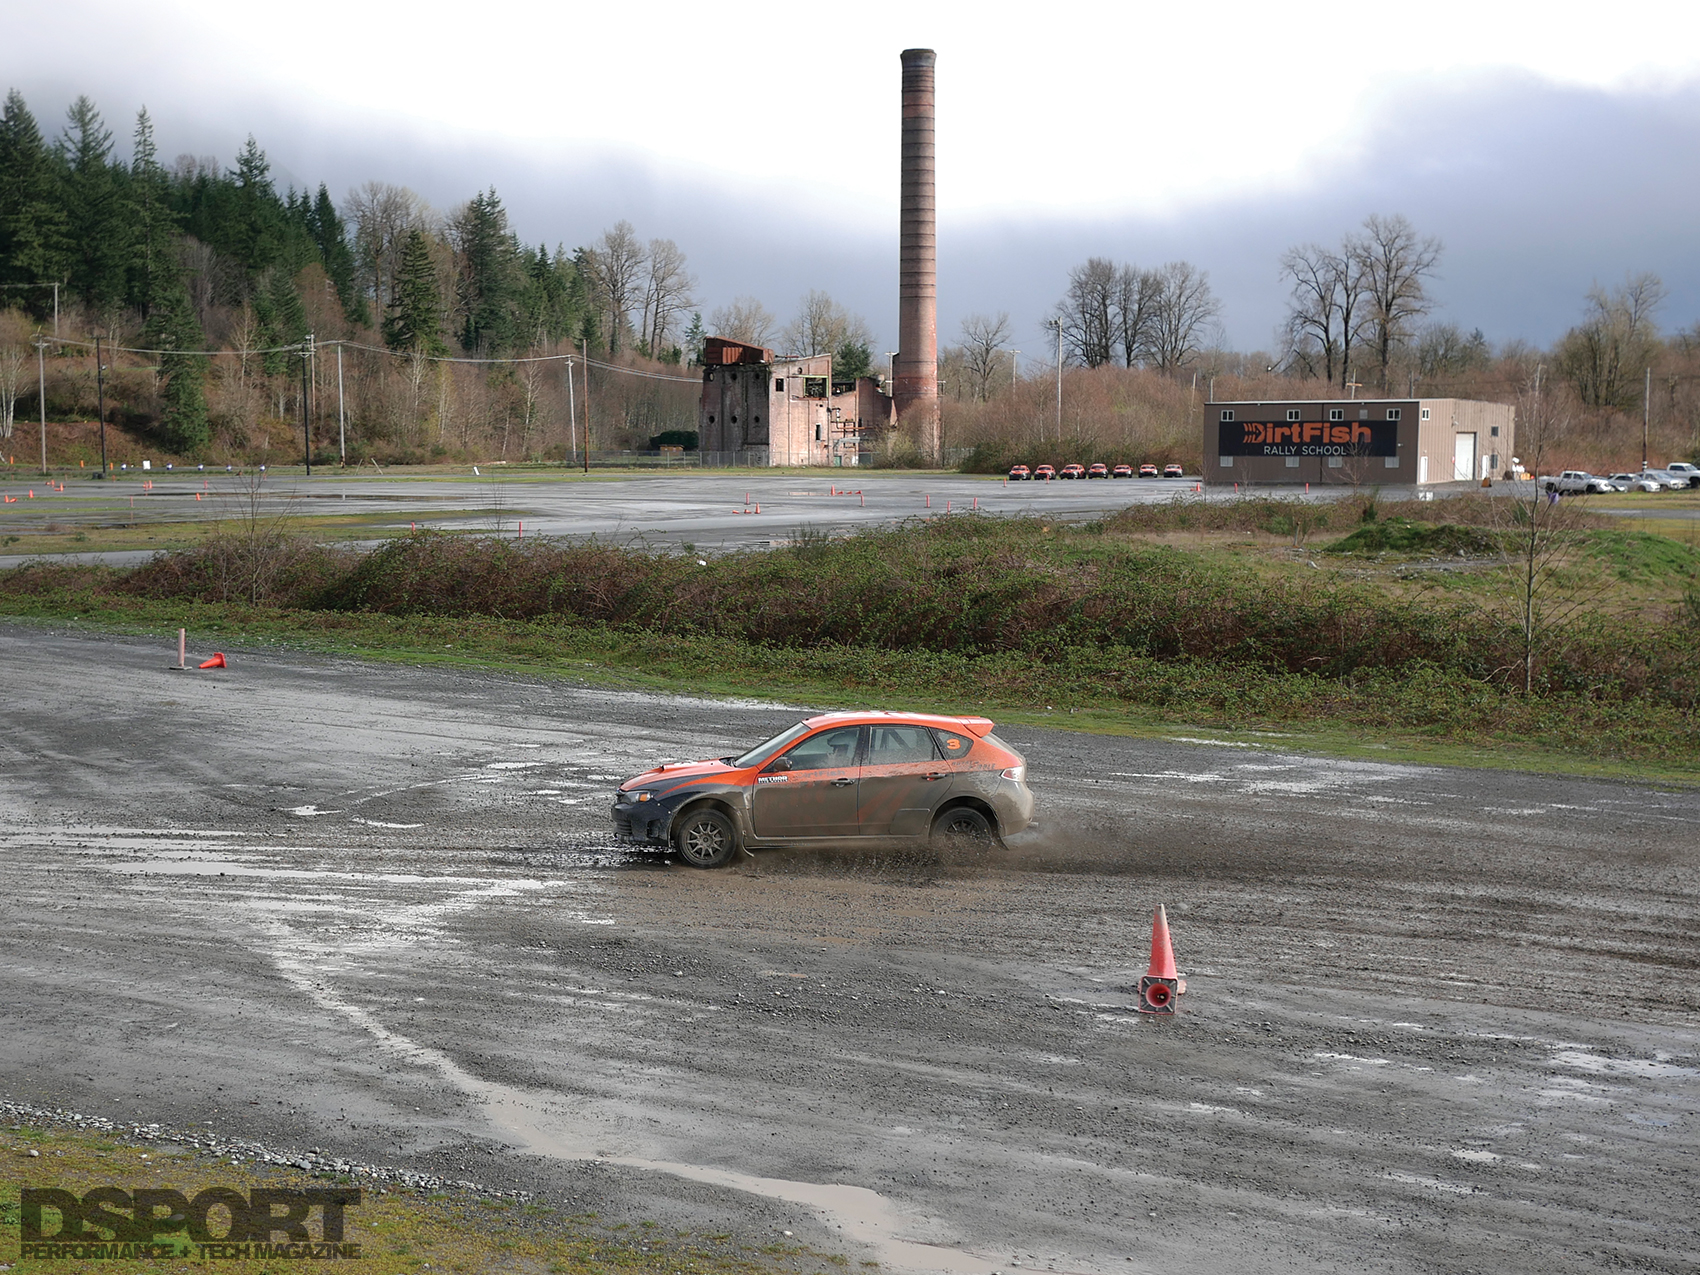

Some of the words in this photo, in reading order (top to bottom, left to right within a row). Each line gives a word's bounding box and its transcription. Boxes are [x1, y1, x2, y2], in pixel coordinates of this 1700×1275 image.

[1243, 422, 1371, 443] DirtFish
[1263, 445, 1297, 455] RALLY
[1302, 445, 1347, 455] SCHOOL
[946, 738, 961, 750] 3
